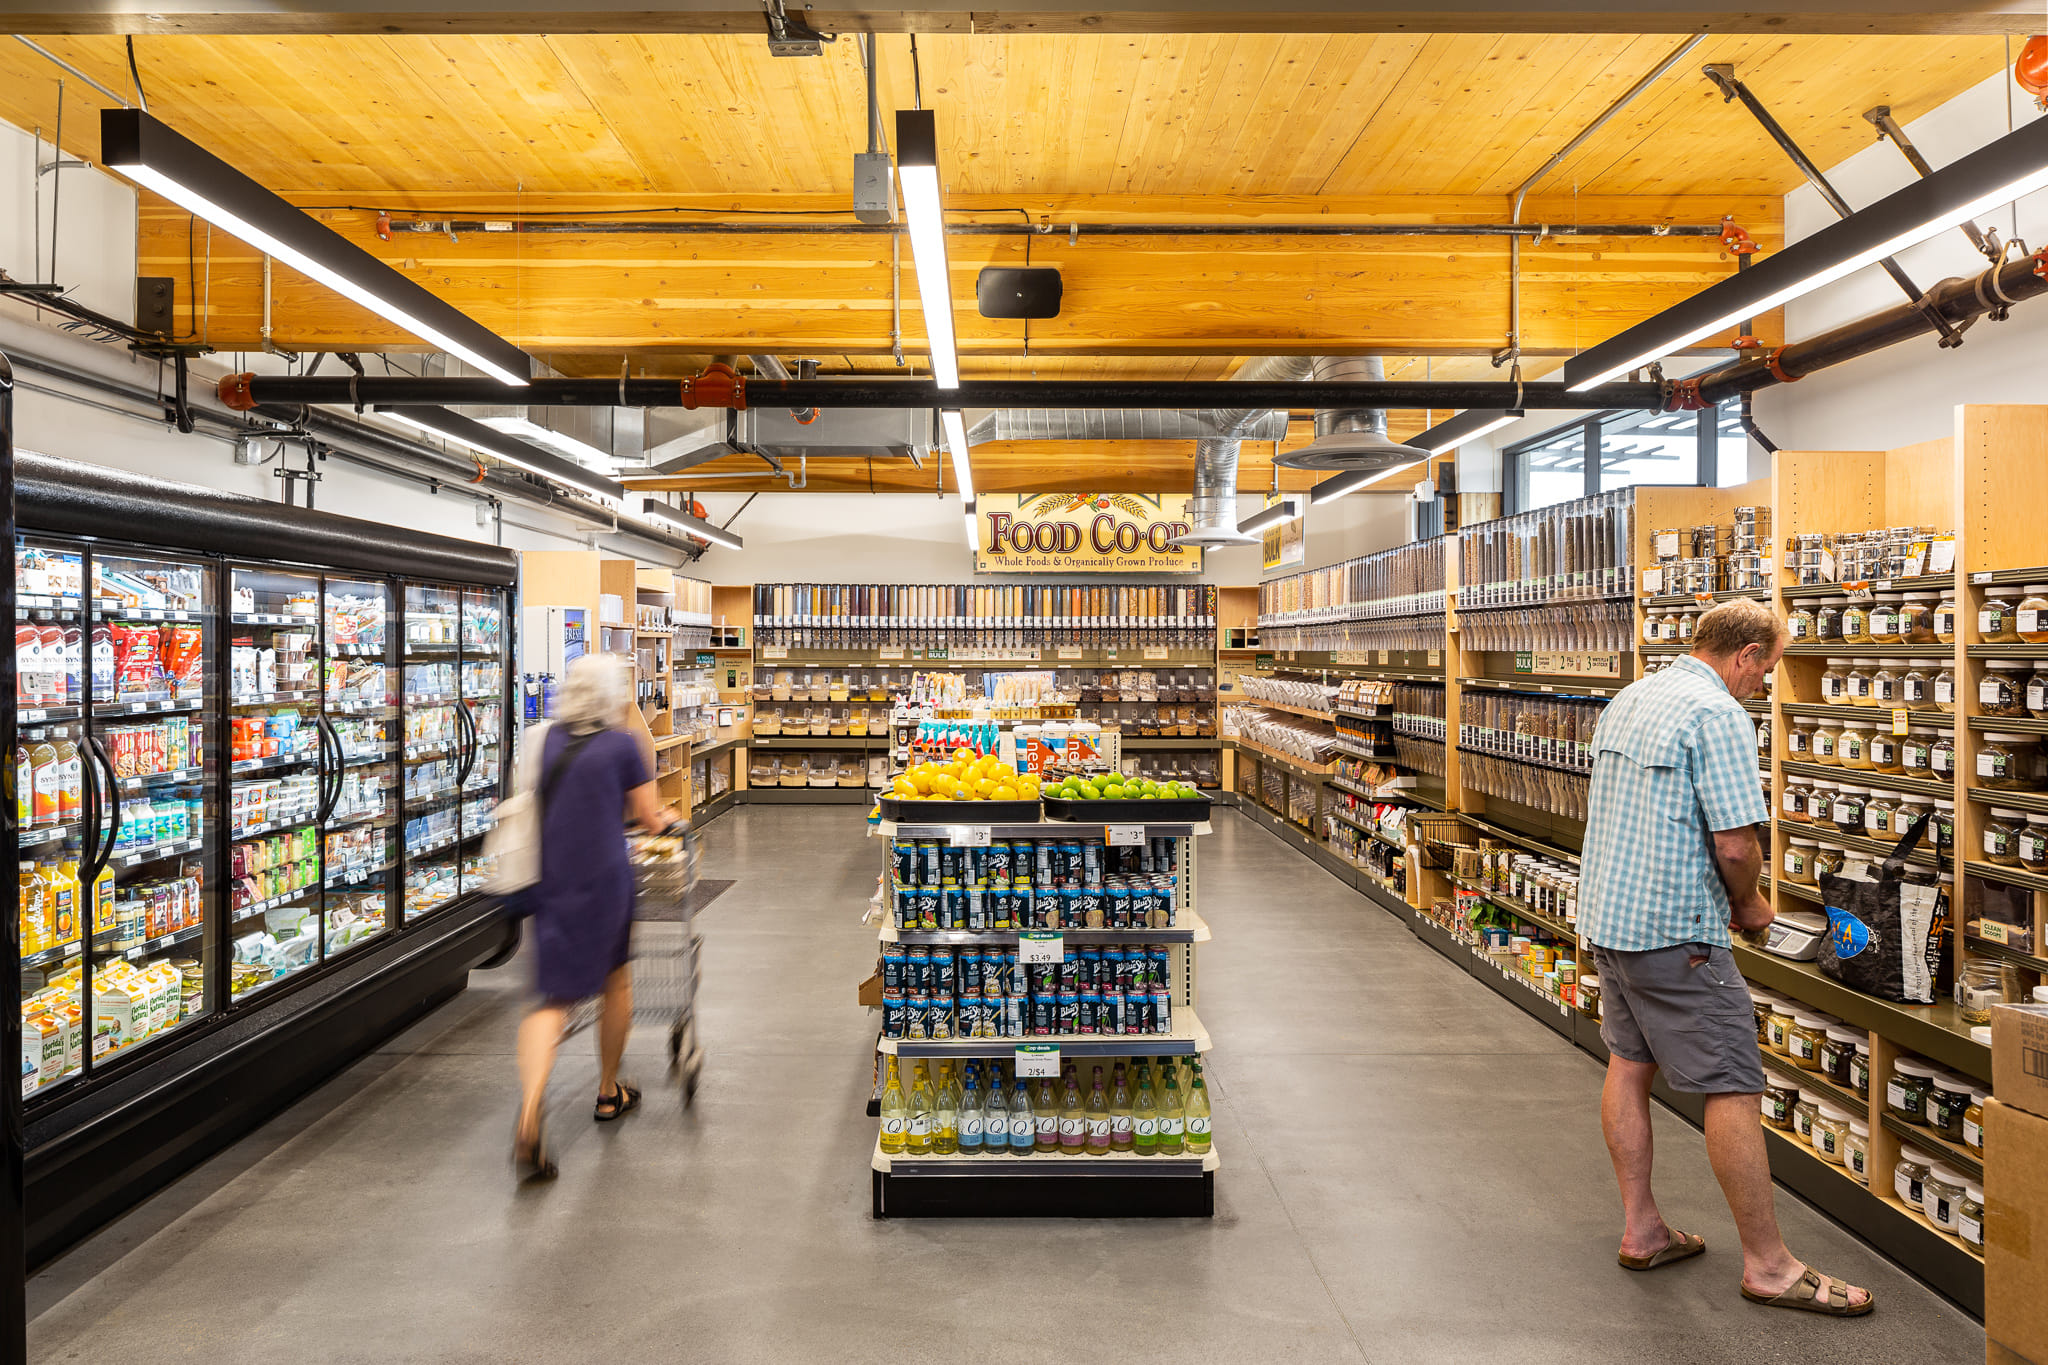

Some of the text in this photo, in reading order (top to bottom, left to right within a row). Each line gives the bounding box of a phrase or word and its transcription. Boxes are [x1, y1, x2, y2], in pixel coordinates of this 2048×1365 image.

[987, 512, 1082, 554] FOOD
[995, 555, 1184, 568] Whole Foods & Organically Grown Produce
[1984, 923, 2002, 933] CLEAN
[1984, 930, 2002, 938] SCOOPS
[1030, 954, 1051, 962] $3.49
[132, 1010, 149, 1022] Natural
[42, 1038, 64, 1052] Florida's
[42, 1048, 64, 1062] Natural
[1028, 1068, 1045, 1076] 2/$4
[888, 1118, 902, 1134] Q
[968, 1118, 981, 1134] Q
[990, 1118, 1004, 1134] Q
[1013, 1120, 1027, 1135] Q
[1042, 1118, 1055, 1133] Q
[1061, 1119, 1075, 1134] Q
[1096, 1120, 1109, 1136] Q
[1118, 1116, 1130, 1132] Q
[1140, 1119, 1154, 1134] Q
[1160, 1118, 1172, 1134] Q
[1190, 1118, 1204, 1134] Q
